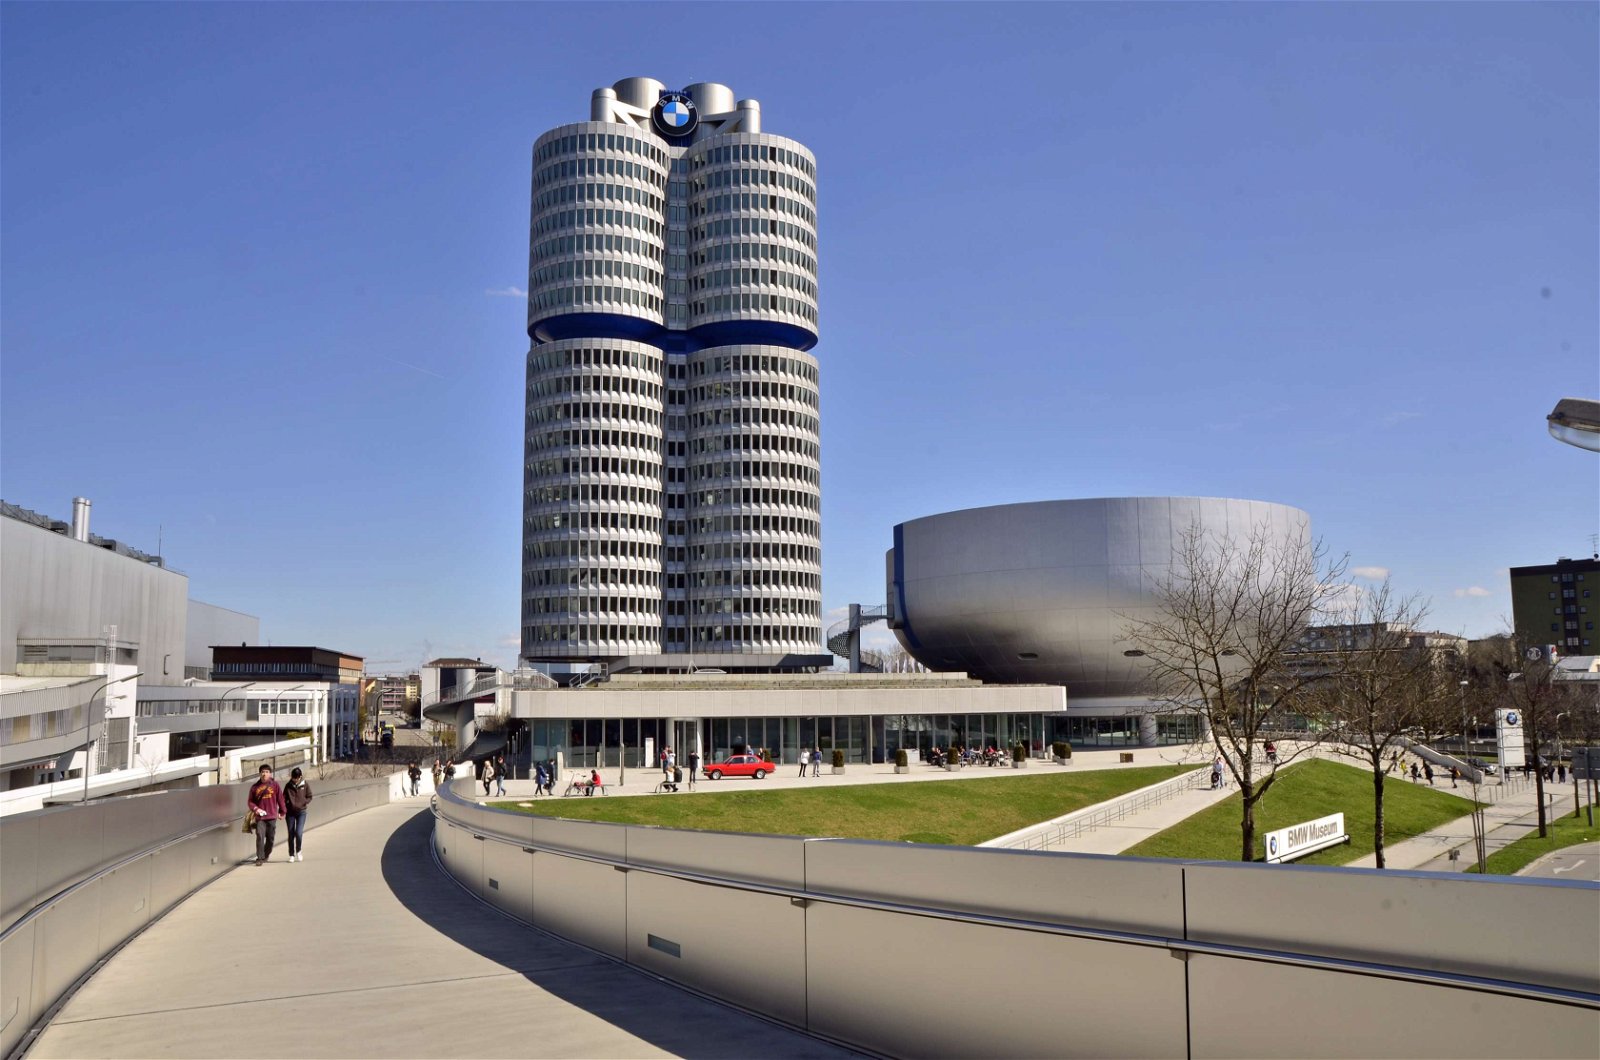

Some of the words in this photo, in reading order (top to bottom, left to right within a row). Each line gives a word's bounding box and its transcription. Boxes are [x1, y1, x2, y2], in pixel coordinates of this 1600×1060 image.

[658, 95, 694, 109] BMW
[1288, 825, 1308, 848] BMW
[1309, 822, 1338, 841] Museum
